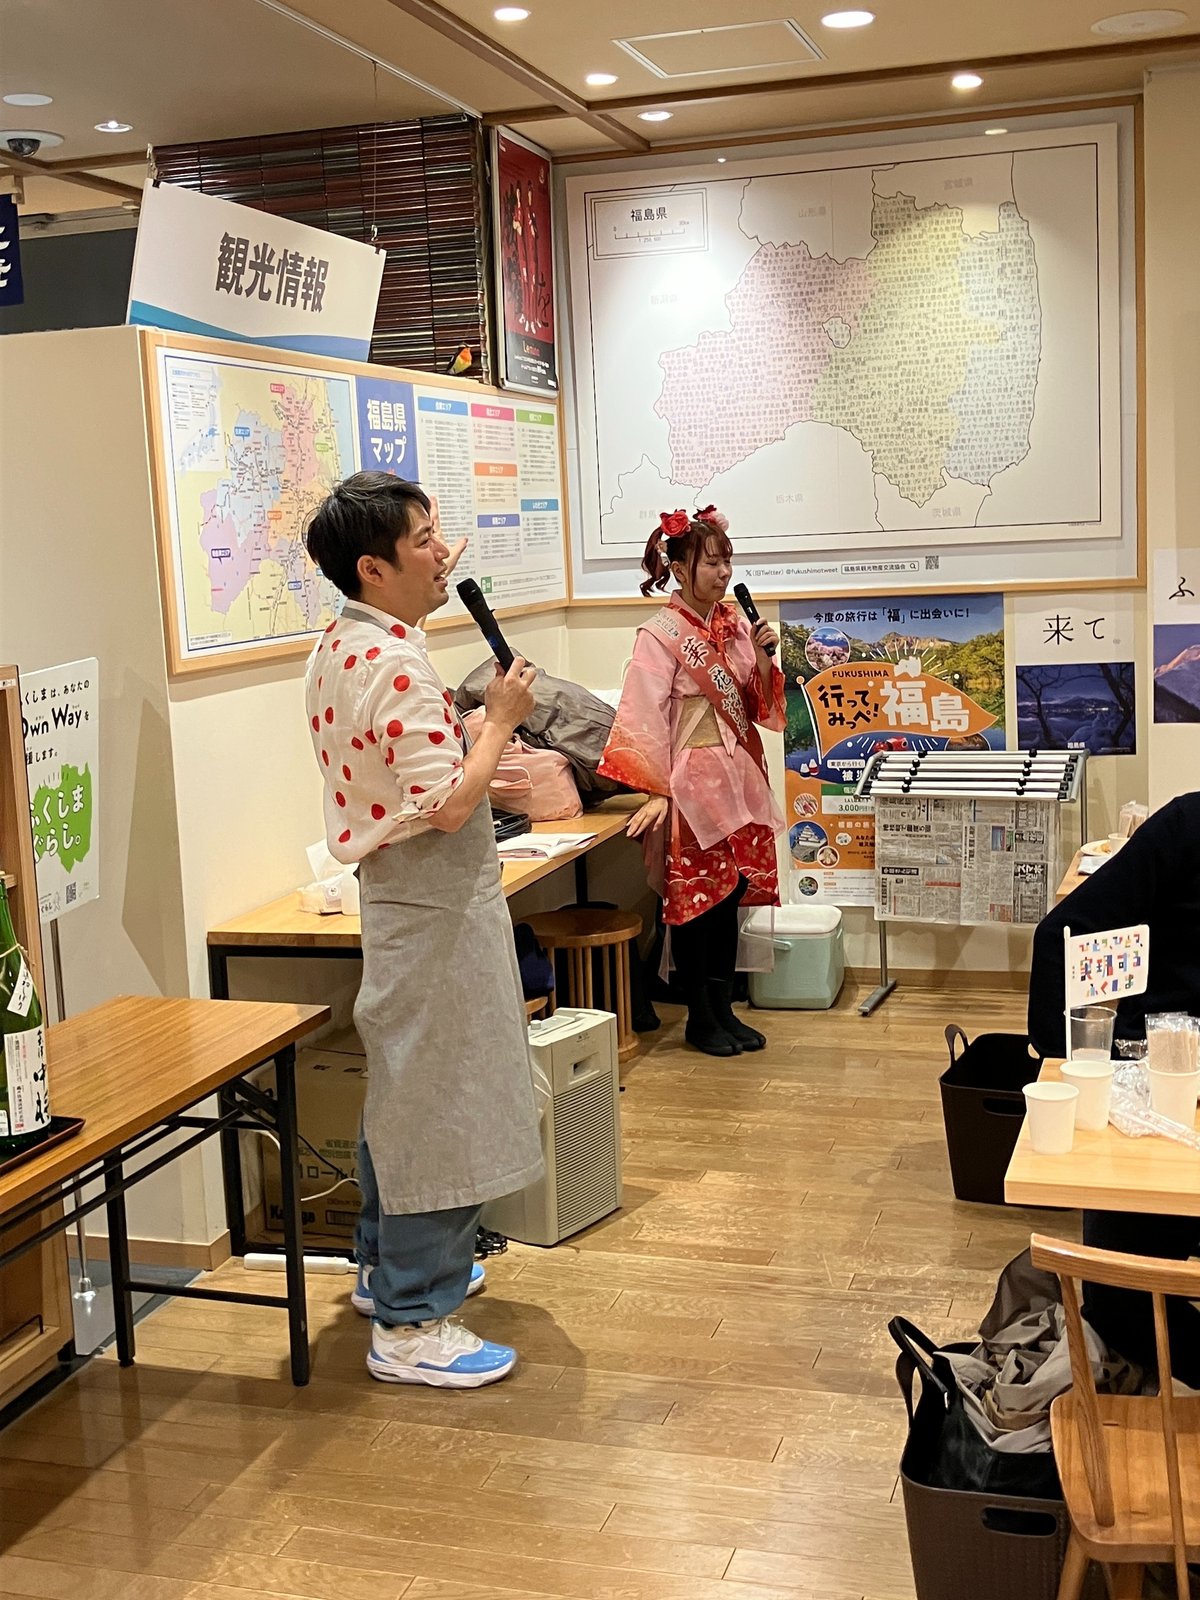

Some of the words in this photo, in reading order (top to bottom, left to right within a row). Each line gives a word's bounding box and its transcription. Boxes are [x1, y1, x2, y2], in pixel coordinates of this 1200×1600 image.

[630, 206, 668, 222] 福島県
[215, 231, 329, 313] 観光情報
[366, 398, 406, 432] 福島県
[370, 435, 407, 464] マップ
[775, 493, 804, 505] 栃木県
[844, 564, 907, 573] 福島県観光物産交流協会
[1168, 576, 1196, 600] ふ
[813, 607, 970, 625] 今度の旅行は「福」に出会いに!
[1042, 613, 1106, 646] 来て
[682, 636, 710, 669] 華
[831, 669, 890, 679] FUKUSHIMA
[21, 679, 90, 706] くしまは、あなたの
[817, 683, 870, 709] 行って
[51, 703, 82, 729] Way
[827, 702, 880, 730] みっぺ!
[879, 680, 971, 733] 福島
